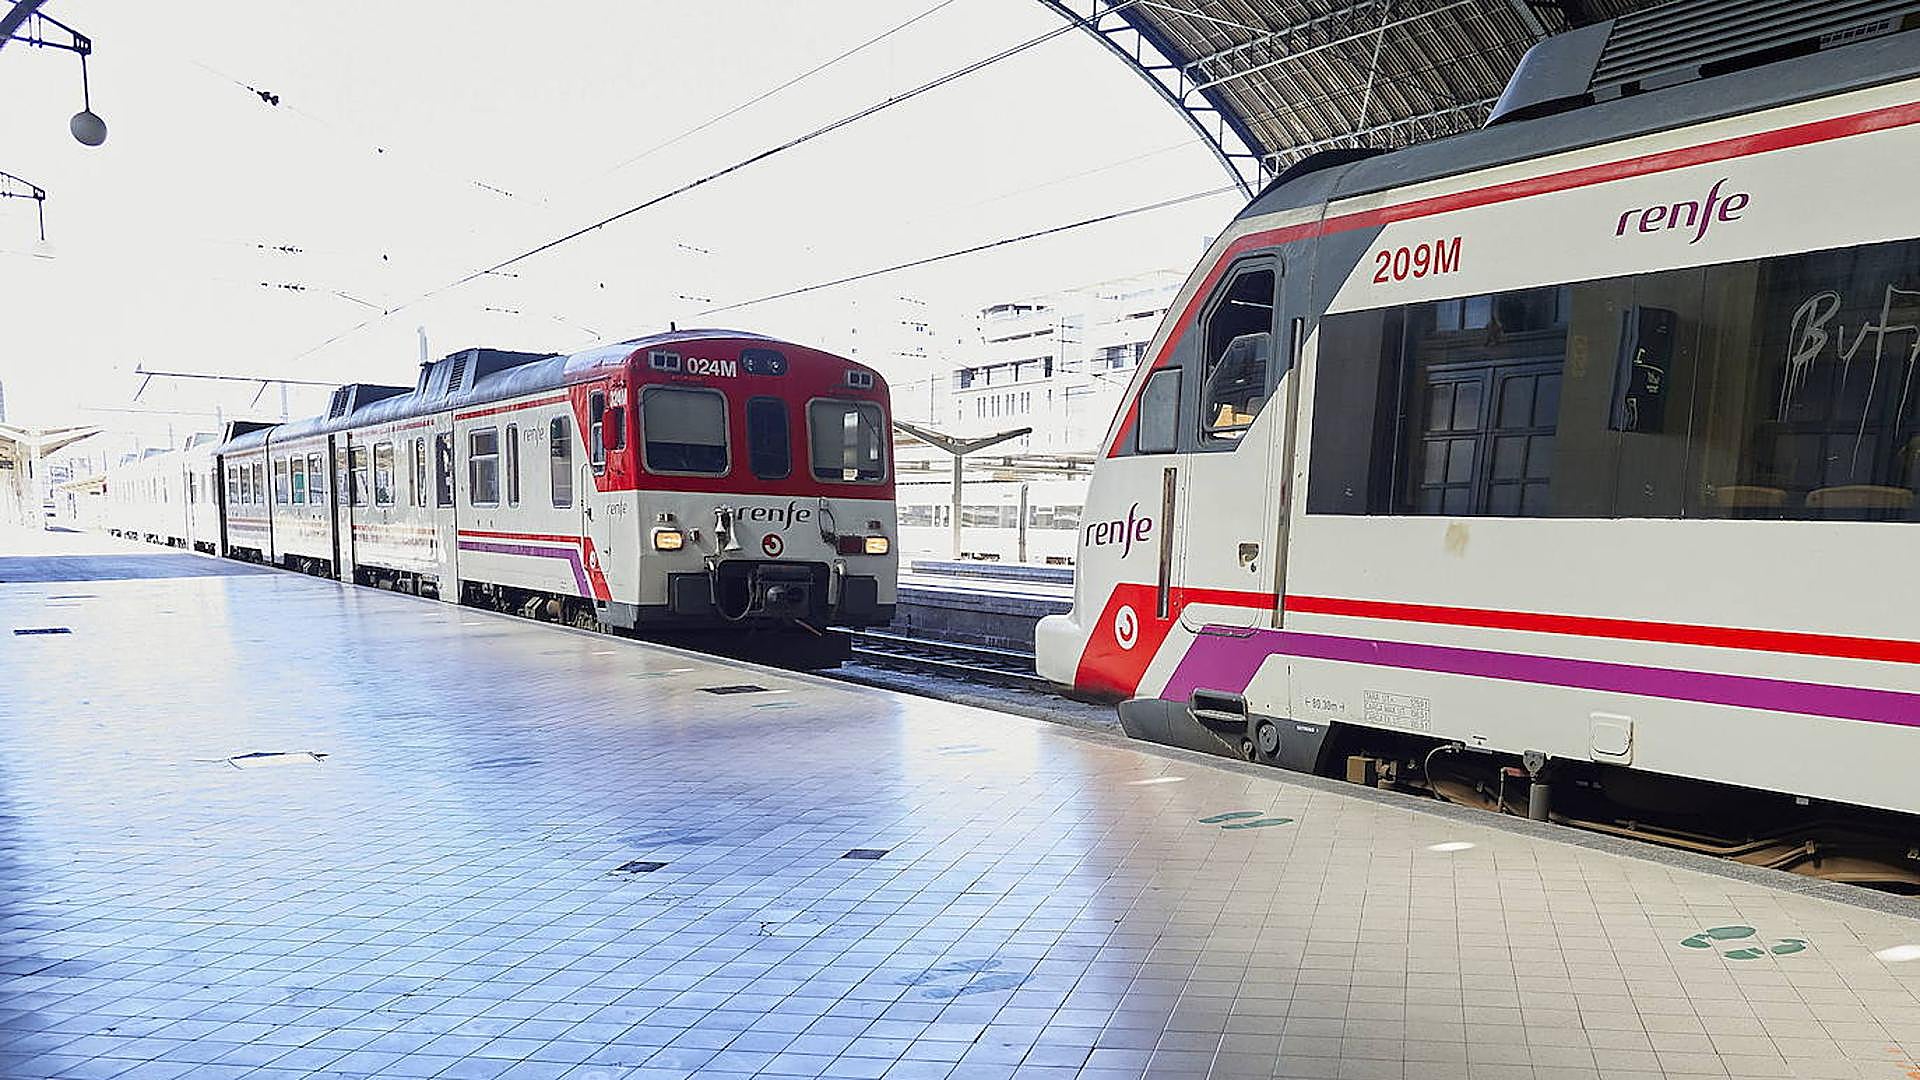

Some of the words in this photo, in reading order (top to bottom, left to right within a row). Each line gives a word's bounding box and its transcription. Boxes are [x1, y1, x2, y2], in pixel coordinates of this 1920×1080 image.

[1616, 178, 1750, 244] renfe
[1373, 236, 1462, 284] 209M
[687, 357, 737, 378] 024M
[737, 501, 811, 531] renfe
[1085, 502, 1153, 559] renfe
